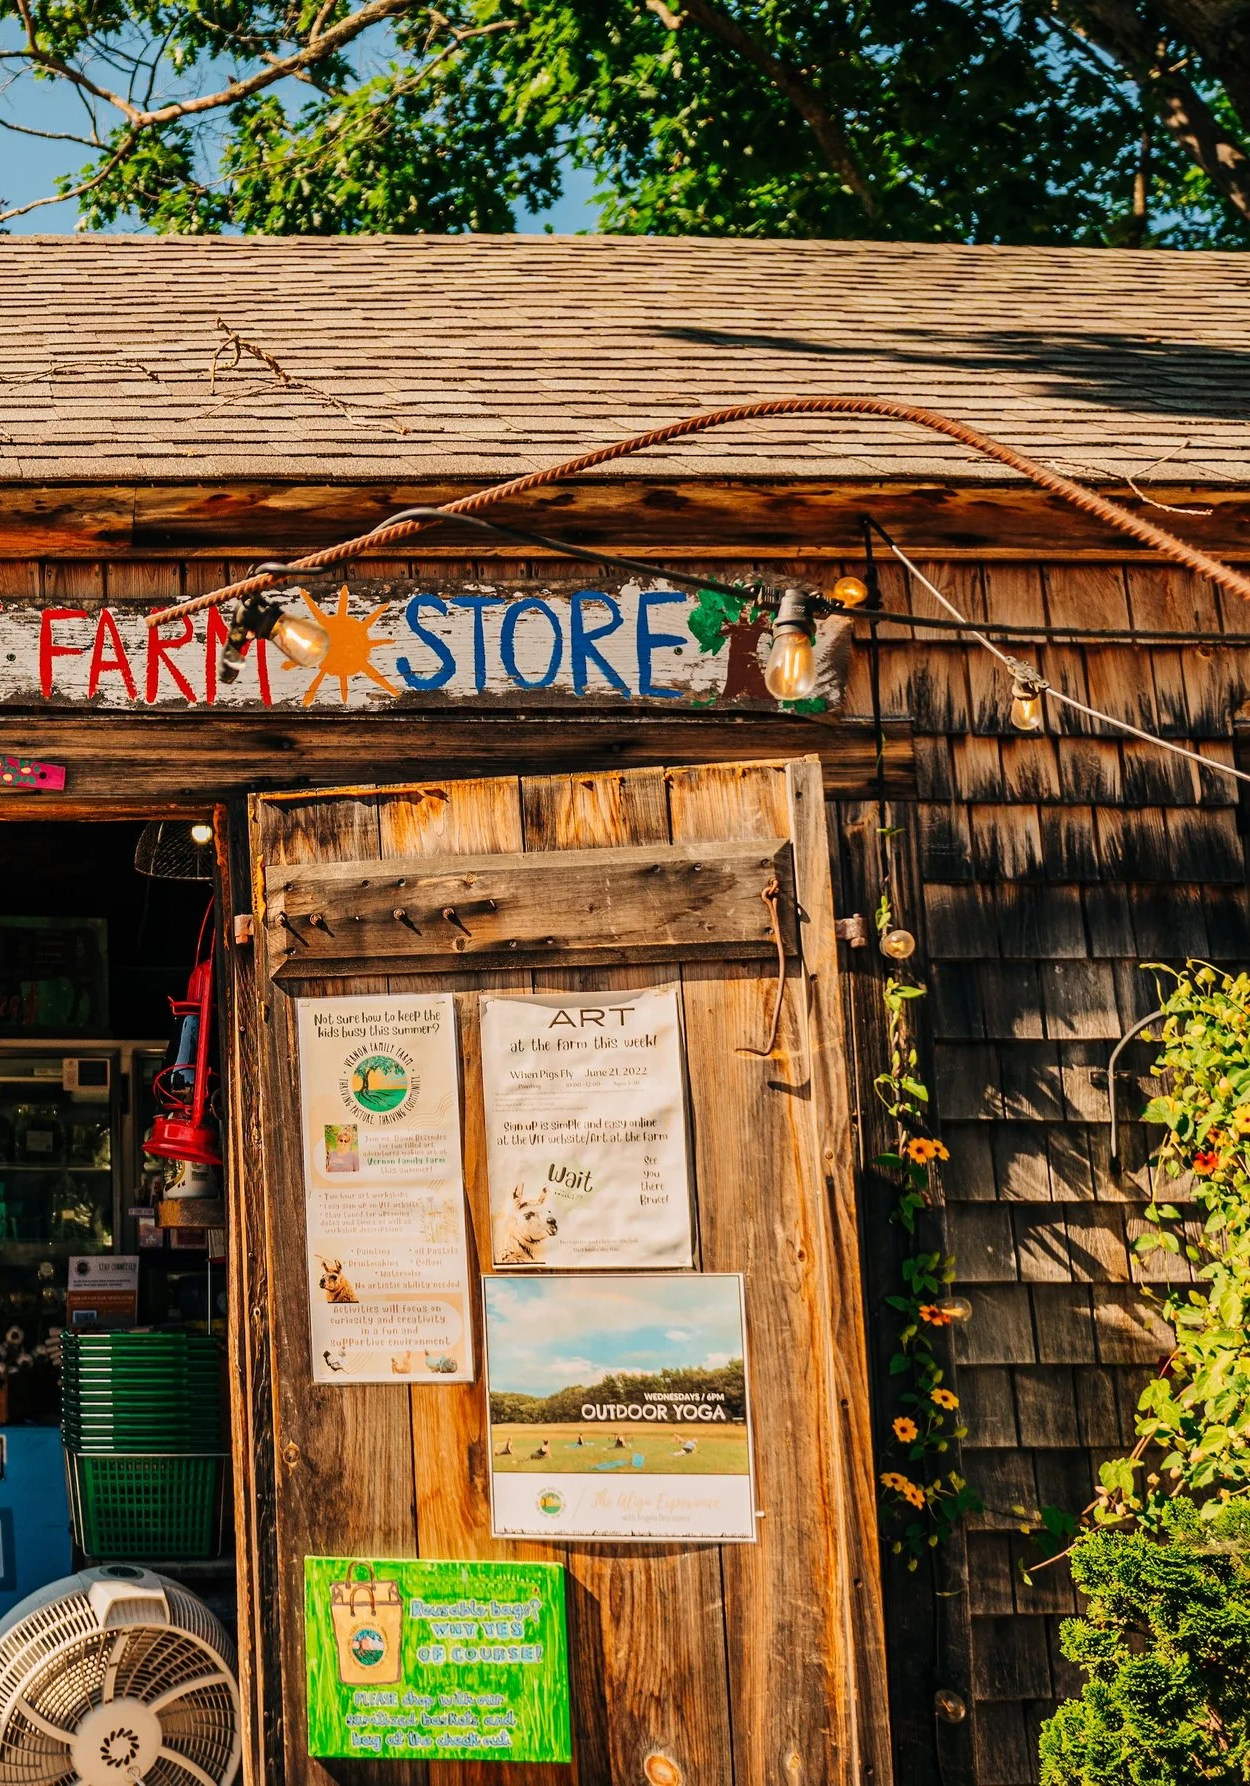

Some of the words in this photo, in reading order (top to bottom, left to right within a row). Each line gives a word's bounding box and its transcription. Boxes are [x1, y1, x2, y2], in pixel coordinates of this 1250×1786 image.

[38, 607, 273, 707] FARM
[395, 591, 688, 698] STORE
[314, 1012, 334, 1026] Not
[336, 1013, 360, 1024] sure
[361, 1012, 382, 1023] how
[384, 1012, 395, 1023] to
[423, 1010, 441, 1021] the
[548, 1007, 635, 1029] ART
[317, 1026, 339, 1038] kids
[341, 1026, 366, 1038] busy
[369, 1025, 389, 1036] this
[392, 1023, 440, 1035] summer?
[510, 1039, 525, 1053] at
[531, 1037, 551, 1051] the
[557, 1037, 588, 1051] farm
[594, 1036, 618, 1050] this
[623, 1034, 658, 1048] week!
[343, 1045, 368, 1068] VERNON
[370, 1042, 395, 1052] FAMILY
[395, 1047, 414, 1066] FARM
[510, 1070, 538, 1079] When
[539, 1069, 559, 1080] Pigs
[560, 1069, 574, 1080] Fly
[584, 1069, 607, 1078] June
[622, 1066, 647, 1076] 2022
[338, 1078, 354, 1107] THRIVING
[379, 1108, 407, 1125] THRIVING
[403, 1075, 421, 1112] COMMUNITY
[503, 1121, 523, 1132] Sign
[540, 1121, 549, 1130] is
[583, 1118, 601, 1130] and
[604, 1120, 627, 1131] easy
[629, 1117, 657, 1128] online
[497, 1135, 509, 1146] at
[511, 1134, 526, 1145] the
[610, 1132, 622, 1143] at
[624, 1131, 641, 1142] the
[643, 1155, 658, 1165] See
[643, 1170, 660, 1179] you
[641, 1181, 664, 1191] there
[382, 1304, 399, 1313] will
[377, 1315, 393, 1324] and
[644, 1392, 700, 1401] WEDNESDAYS
[706, 1392, 725, 1401] 6PM
[581, 1403, 668, 1421] OUTDOOR
[671, 1403, 726, 1420] YOGA
[411, 1601, 487, 1617] Reusable
[490, 1600, 541, 1622] bags?
[432, 1622, 478, 1637] WHY
[481, 1622, 524, 1638] YES
[417, 1647, 445, 1663] OF
[452, 1646, 543, 1663] COURSE!
[354, 1692, 398, 1706] PLEASE
[402, 1691, 434, 1709] shop
[439, 1691, 476, 1706] with
[477, 1694, 505, 1706] our
[346, 1711, 417, 1726] sanitized
[421, 1711, 479, 1726] baskets
[484, 1711, 516, 1726] and
[351, 1731, 382, 1750] bag
[385, 1732, 404, 1746] at
[407, 1731, 433, 1746] the
[436, 1732, 481, 1746] check
